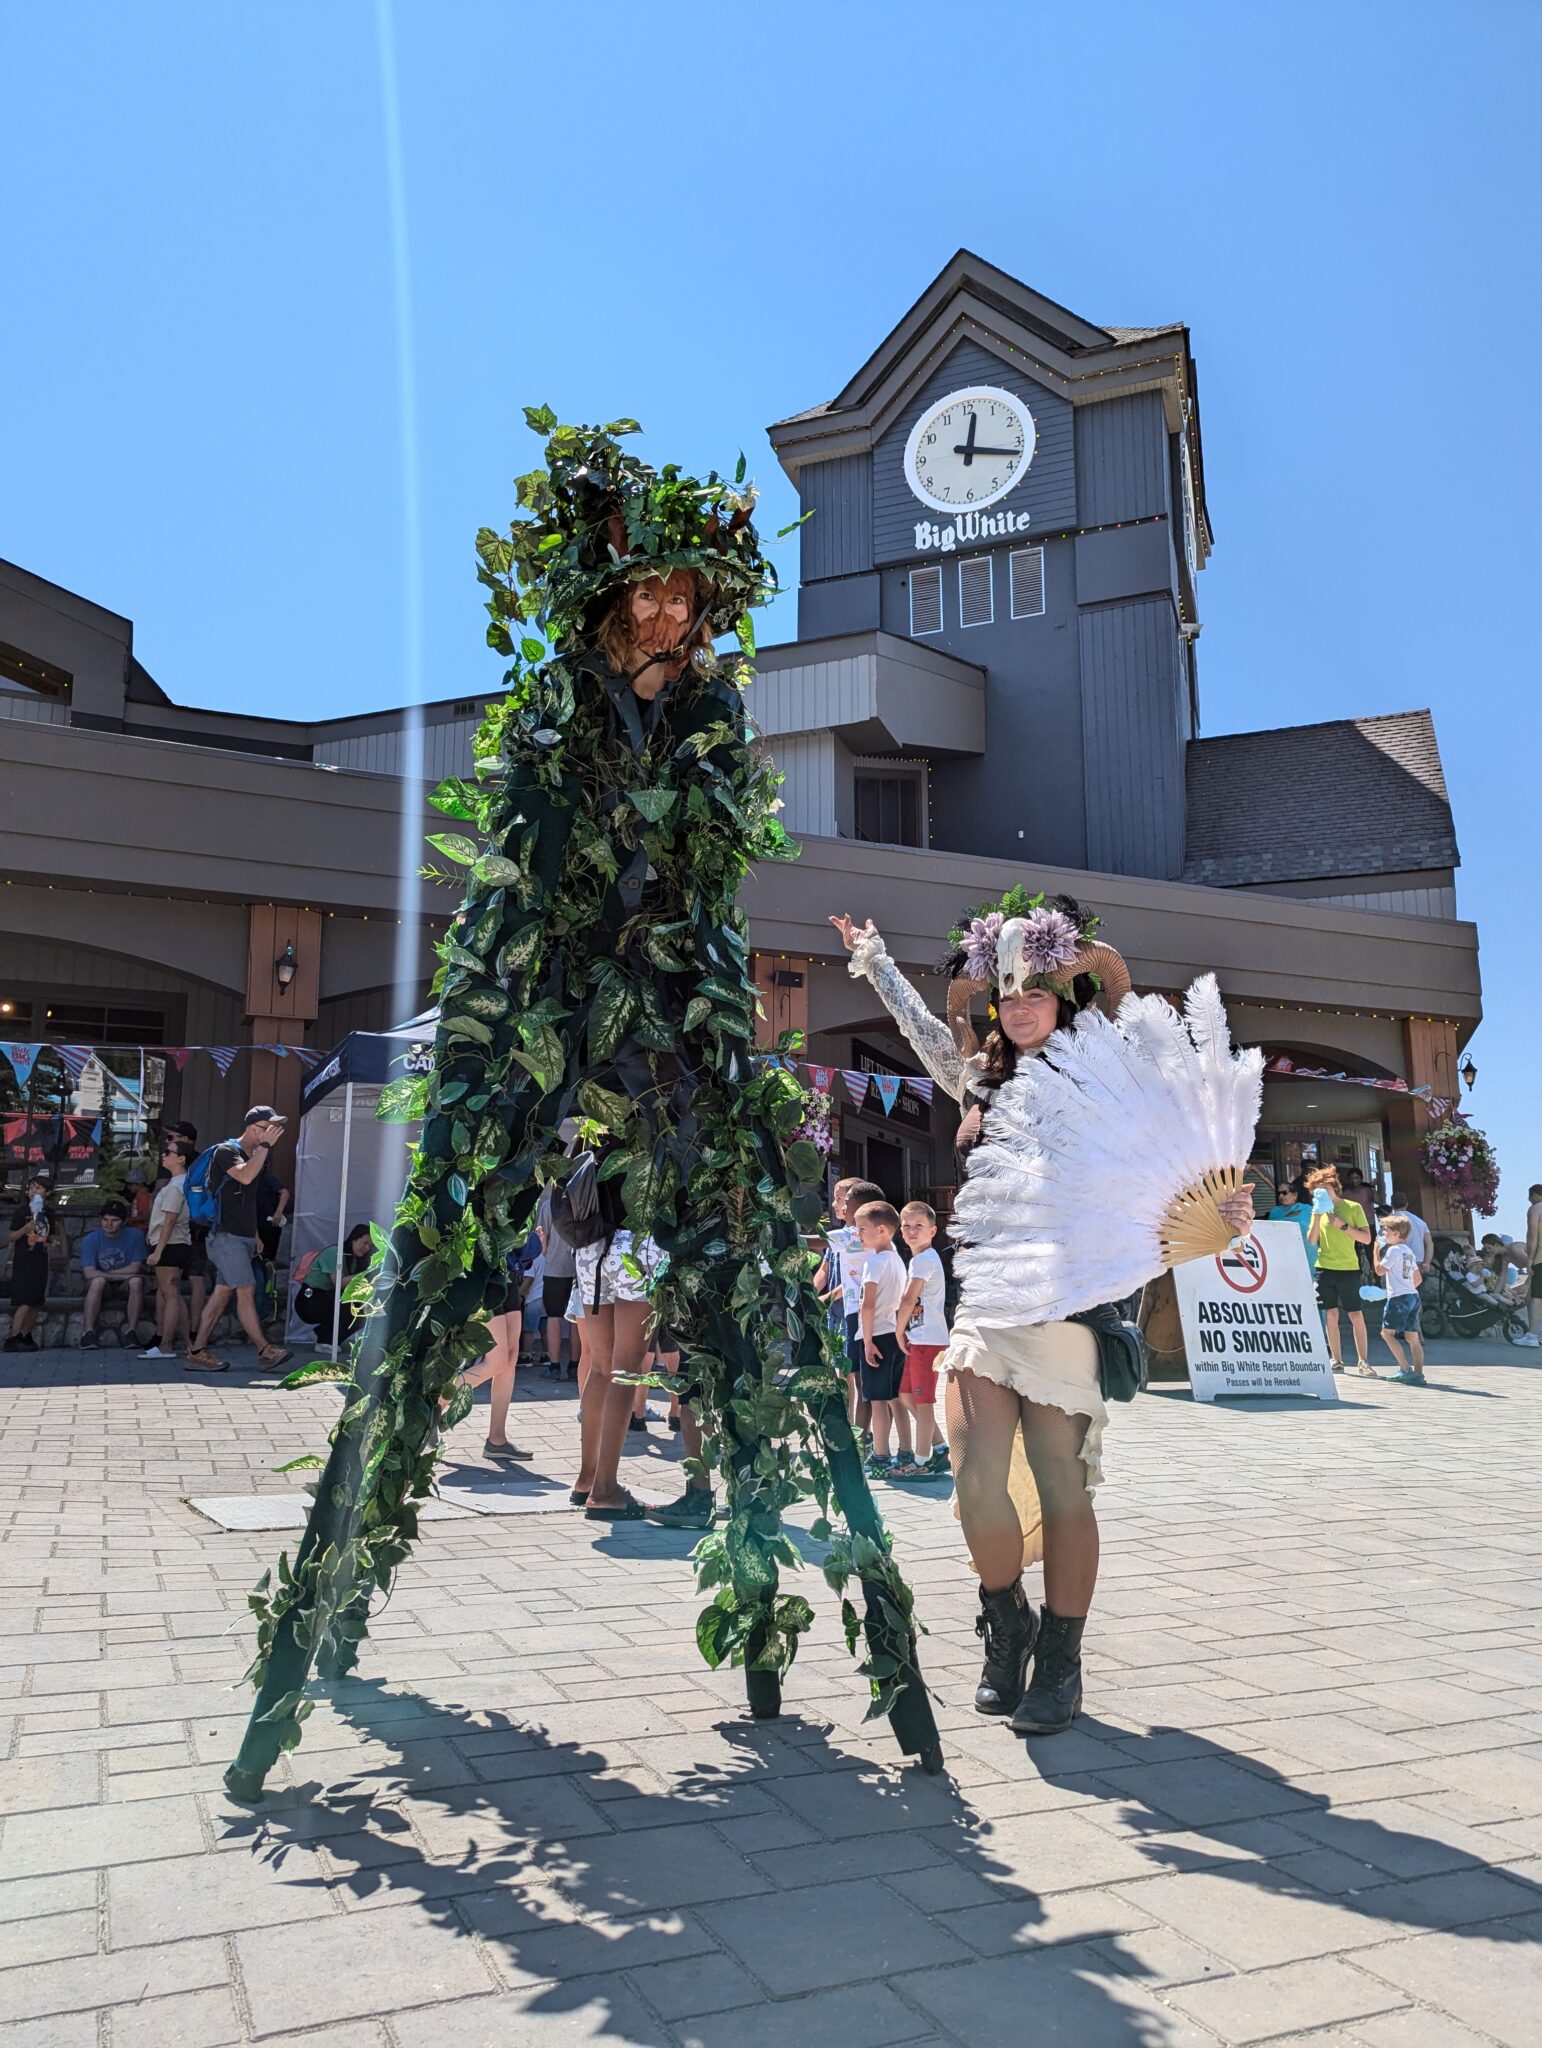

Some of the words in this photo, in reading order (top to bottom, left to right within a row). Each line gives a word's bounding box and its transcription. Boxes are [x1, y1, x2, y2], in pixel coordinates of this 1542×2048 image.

[962, 404, 973, 416] 12
[990, 405, 995, 416] 1
[943, 415, 951, 426] 11
[1006, 416, 1014, 427] 2
[927, 433, 937, 445] 10
[1014, 436, 1021, 448] 3
[919, 456, 927, 467] 9
[1006, 460, 1014, 470] 4
[926, 476, 934, 487] 8
[991, 477, 998, 489] 5
[943, 487, 950, 498] 7
[966, 488, 974, 500] 6
[859, 1053, 876, 1075] LIFT
[901, 1095, 920, 1117] SHOPS
[1198, 1301, 1303, 1325] ABSOLUTELY
[1199, 1329, 1226, 1353] NO
[1231, 1330, 1313, 1353] SMOKING
[1194, 1361, 1220, 1372] within
[1221, 1360, 1235, 1374] Big
[1236, 1360, 1261, 1372] White
[1262, 1360, 1289, 1372] Resort
[1289, 1360, 1326, 1374] Boundary
[1225, 1377, 1250, 1387] Passes
[1251, 1377, 1263, 1387] will
[1264, 1377, 1273, 1387] be
[1274, 1377, 1301, 1387] Revoked
